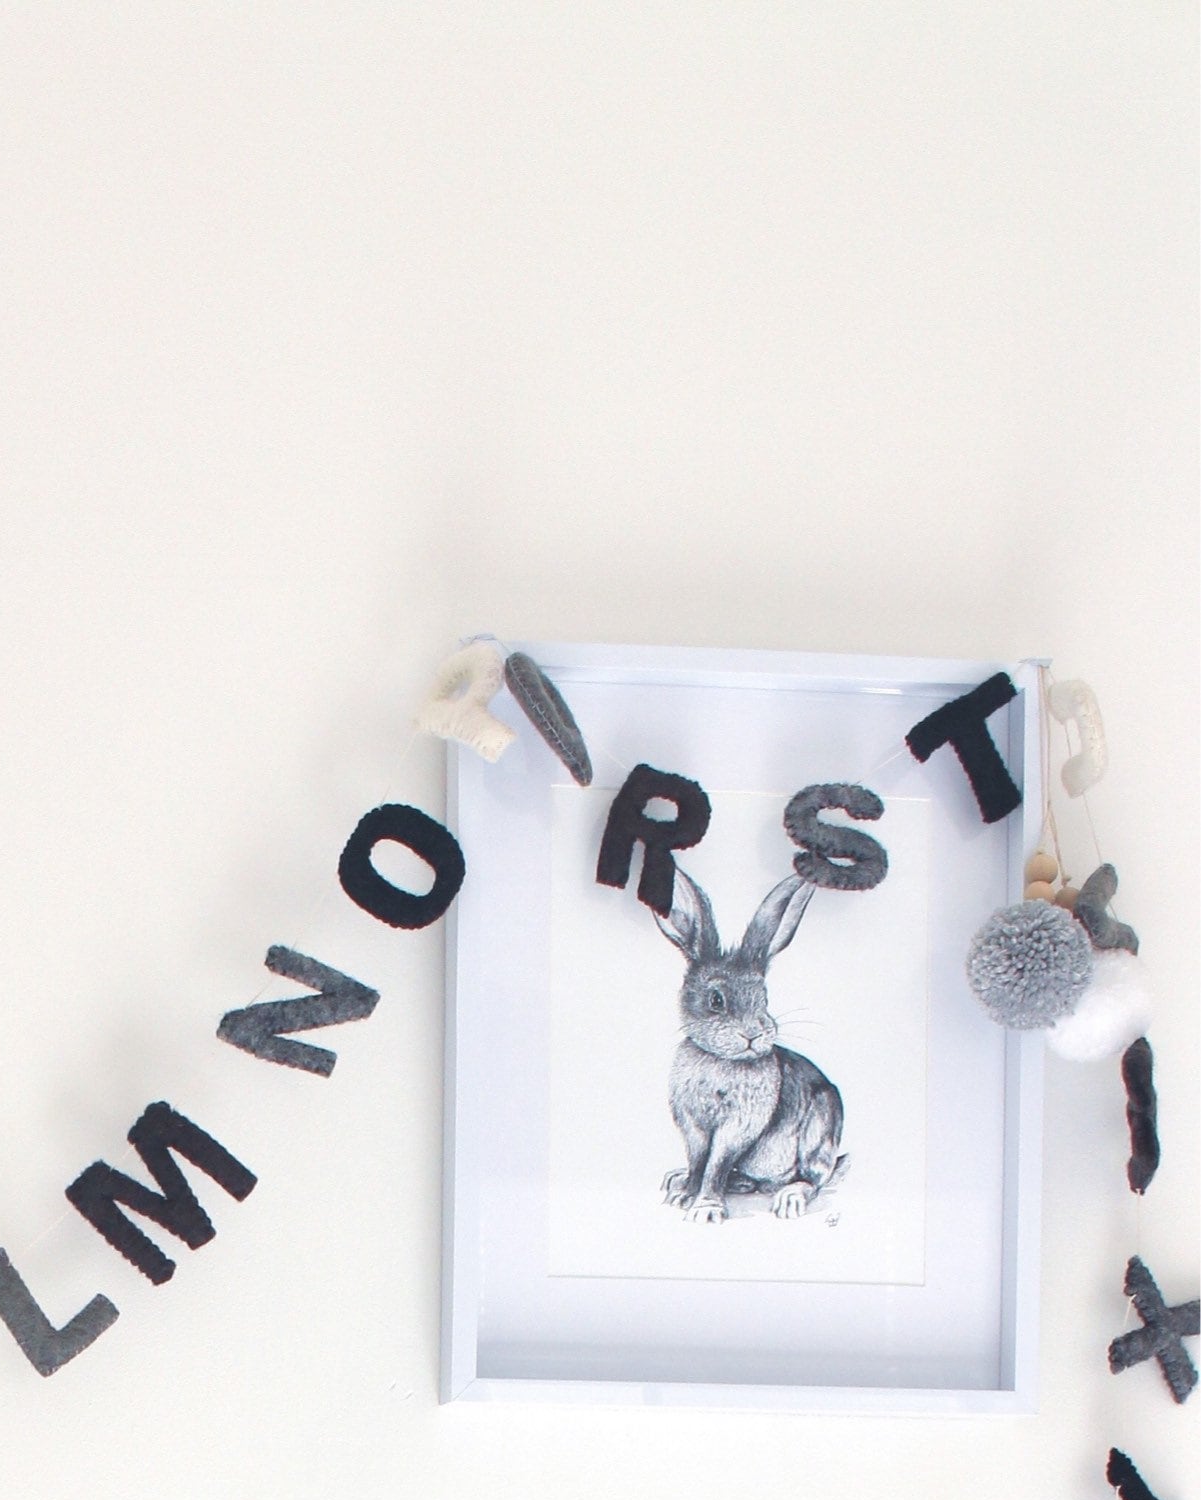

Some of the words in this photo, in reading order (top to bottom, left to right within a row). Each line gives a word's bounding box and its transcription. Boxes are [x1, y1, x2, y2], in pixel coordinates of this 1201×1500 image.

[65, 1100, 258, 1286] M
[216, 944, 381, 1078] N
[338, 803, 466, 930] O
[596, 763, 711, 918] R
[784, 782, 888, 891] S
[905, 671, 1023, 824] T
[1108, 1255, 1201, 1404] X
